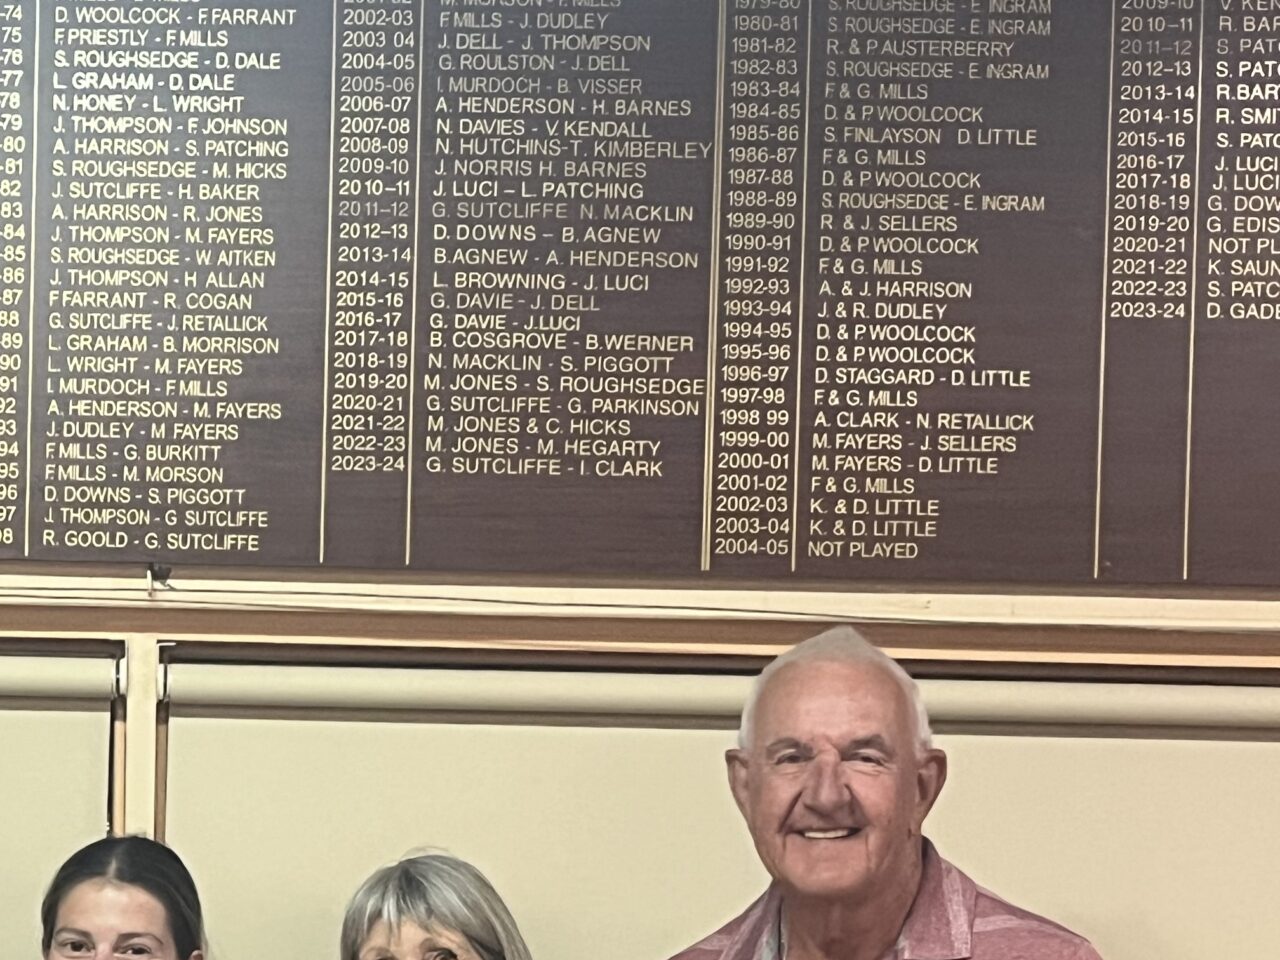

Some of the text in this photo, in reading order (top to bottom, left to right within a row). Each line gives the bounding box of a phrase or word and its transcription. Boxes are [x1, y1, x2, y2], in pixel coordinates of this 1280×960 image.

[73, 49, 200, 69] ROUGHSEDGE
[234, 52, 281, 70] DALE
[339, 95, 412, 113] 2006-07
[458, 96, 575, 115] HENDERSON
[614, 99, 692, 117] BARNES
[1118, 107, 1194, 125] 2014-15
[74, 137, 169, 156] HARRISON
[205, 139, 289, 158] PATCHING
[1116, 153, 1185, 170] 2016-17
[1235, 155, 1278, 172] LUCI
[1112, 236, 1186, 253] 2020-21
[725, 255, 790, 273] 1991-92
[832, 257, 845, 275] &
[873, 258, 923, 276] MILLS
[335, 270, 409, 289] 2014-15
[454, 271, 566, 291] BROWNING
[604, 274, 649, 291] LUCI
[724, 277, 790, 295] 1992-93
[841, 280, 853, 296] &
[876, 280, 972, 299] HARRISON
[723, 299, 792, 317] 1993-94
[835, 301, 847, 318] &
[874, 302, 948, 320] DUDLEY
[1110, 301, 1185, 319] 2023-24
[68, 312, 153, 331] SUTCLIFFE
[182, 314, 268, 332] RETALLICK
[68, 399, 178, 418] HENDERSON
[216, 401, 282, 420] FAYERS
[331, 393, 403, 412] 2020-21
[450, 395, 551, 414] SUTCLIFFE
[591, 397, 699, 416] PARKINSON
[332, 434, 406, 452] 2022-23
[450, 436, 519, 455] JONES
[564, 438, 661, 457] HEGARTY
[715, 494, 788, 513] 2002-03
[834, 498, 848, 515] &
[875, 498, 940, 517] LITTLE
[64, 529, 129, 548] GOOLD
[166, 532, 260, 552] SUTCLIFFE
[714, 537, 919, 559] 2004-05 NOT PLAYED
